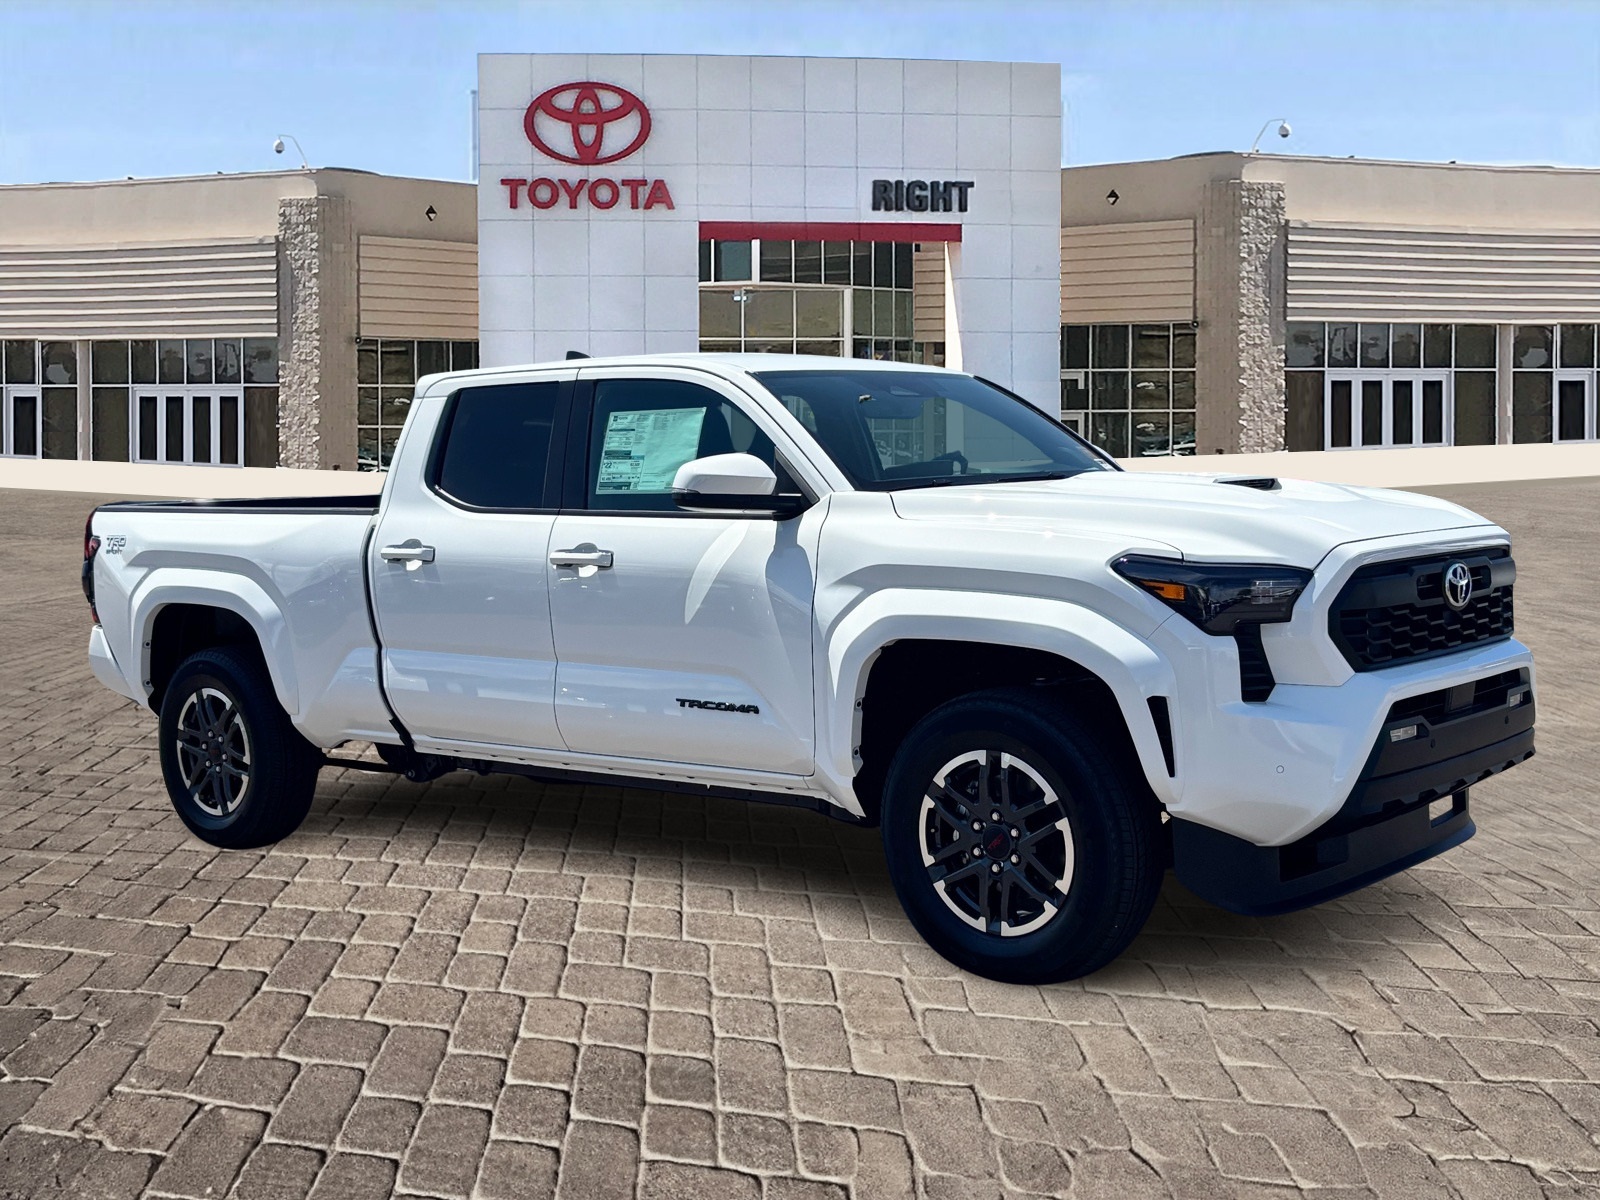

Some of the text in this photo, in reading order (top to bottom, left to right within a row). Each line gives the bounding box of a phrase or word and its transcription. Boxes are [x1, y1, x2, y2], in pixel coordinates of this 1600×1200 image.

[500, 178, 675, 210] TOYOTA
[871, 178, 975, 213] RIGHT
[675, 698, 760, 714] TACOMA
